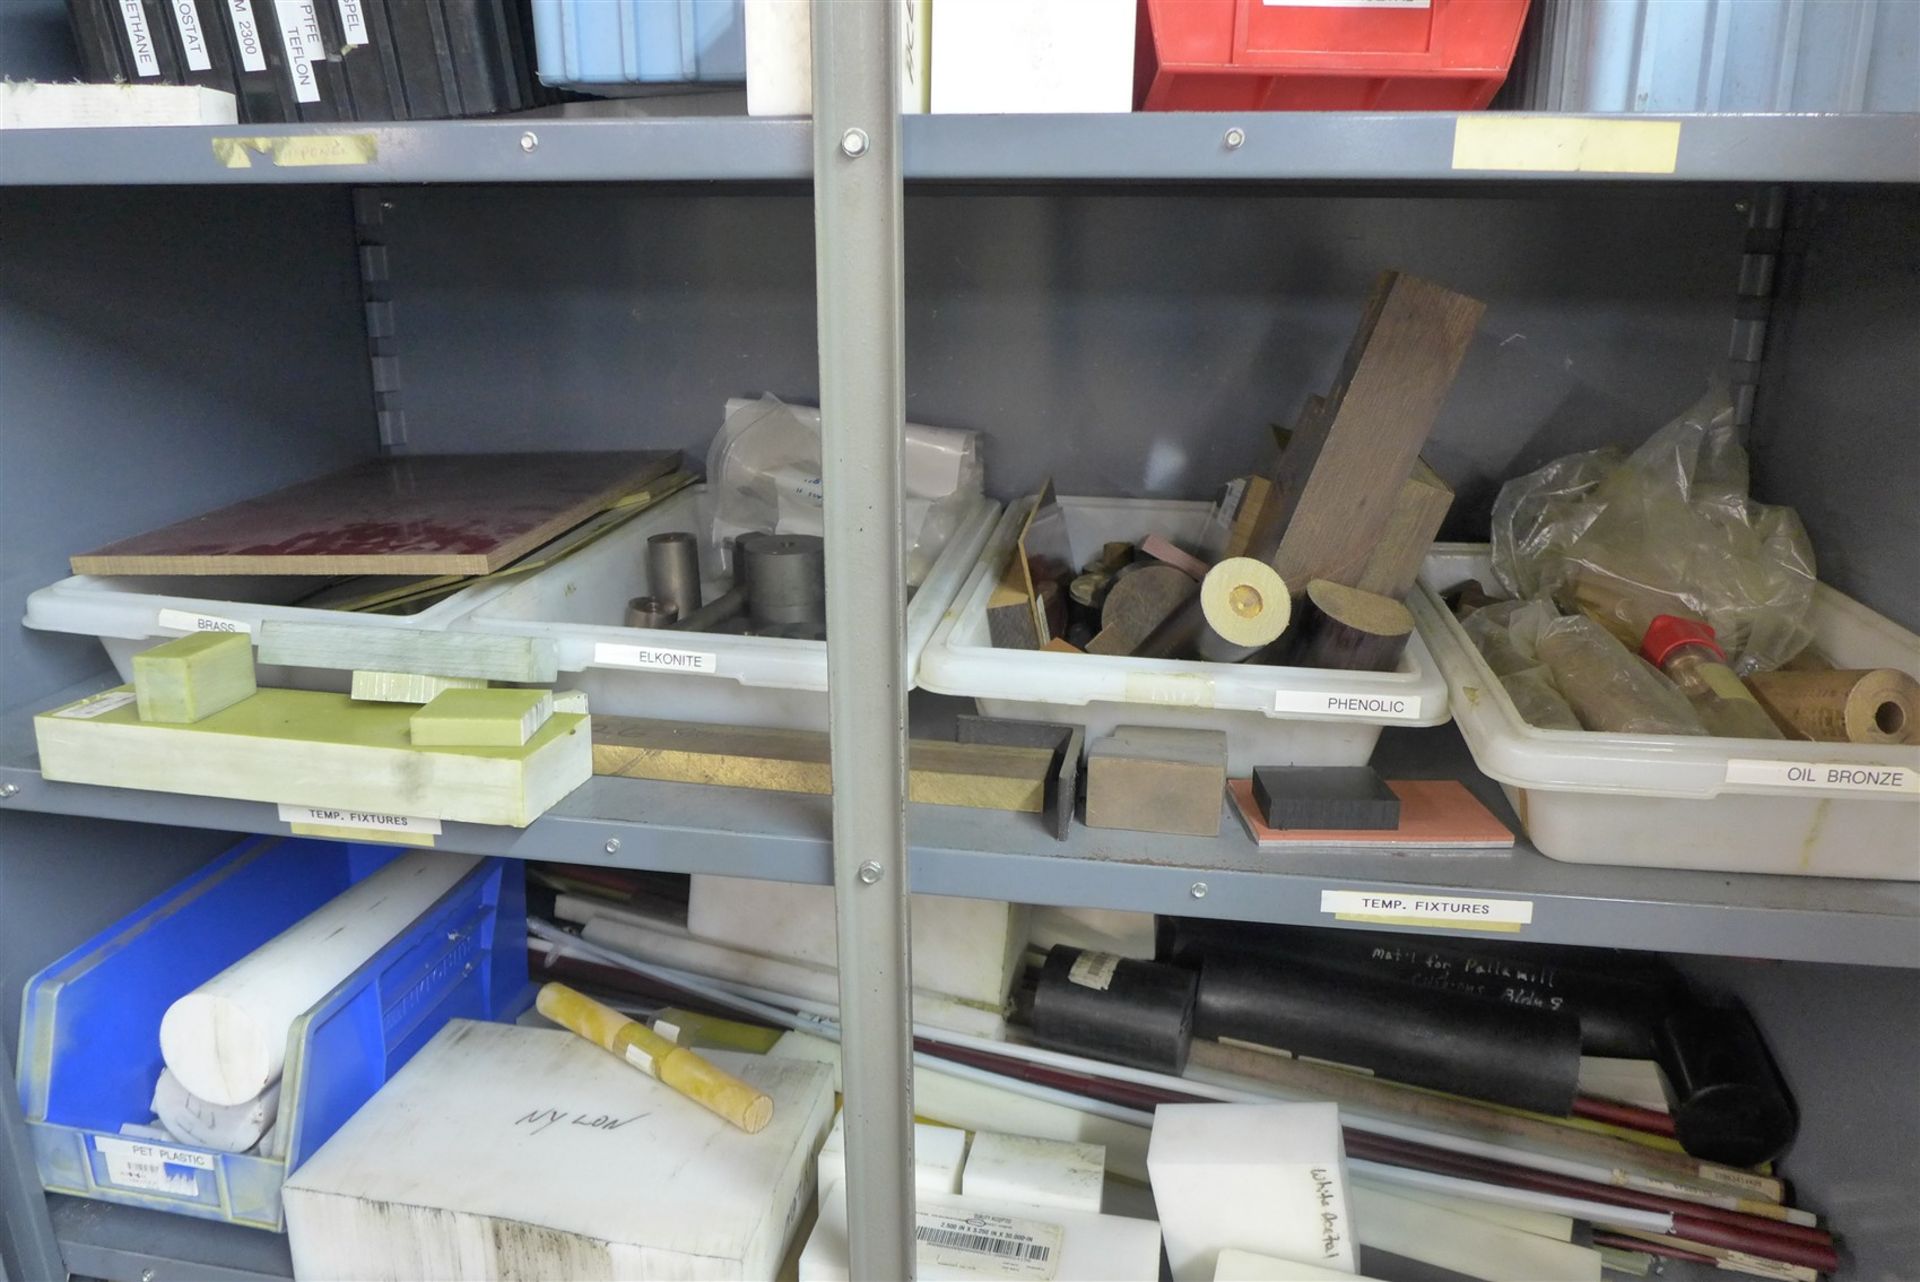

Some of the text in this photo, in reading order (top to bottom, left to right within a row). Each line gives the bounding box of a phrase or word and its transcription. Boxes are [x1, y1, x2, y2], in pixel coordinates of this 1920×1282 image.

[126, 0, 152, 64] ETHANE
[300, 4, 319, 44] PTFE
[239, 21, 257, 55] 2300
[287, 26, 310, 86] TEFLON
[197, 618, 236, 632] BRASS
[639, 650, 703, 668] ELKONITE
[1327, 697, 1405, 713] PHENOLIC
[1787, 767, 1904, 787] OIL BRONZE
[308, 808, 409, 826] TEMP. FIXTURES
[1361, 898, 1491, 915] TEMP. FIXTURES
[132, 1144, 205, 1166] PET PLASTIC
